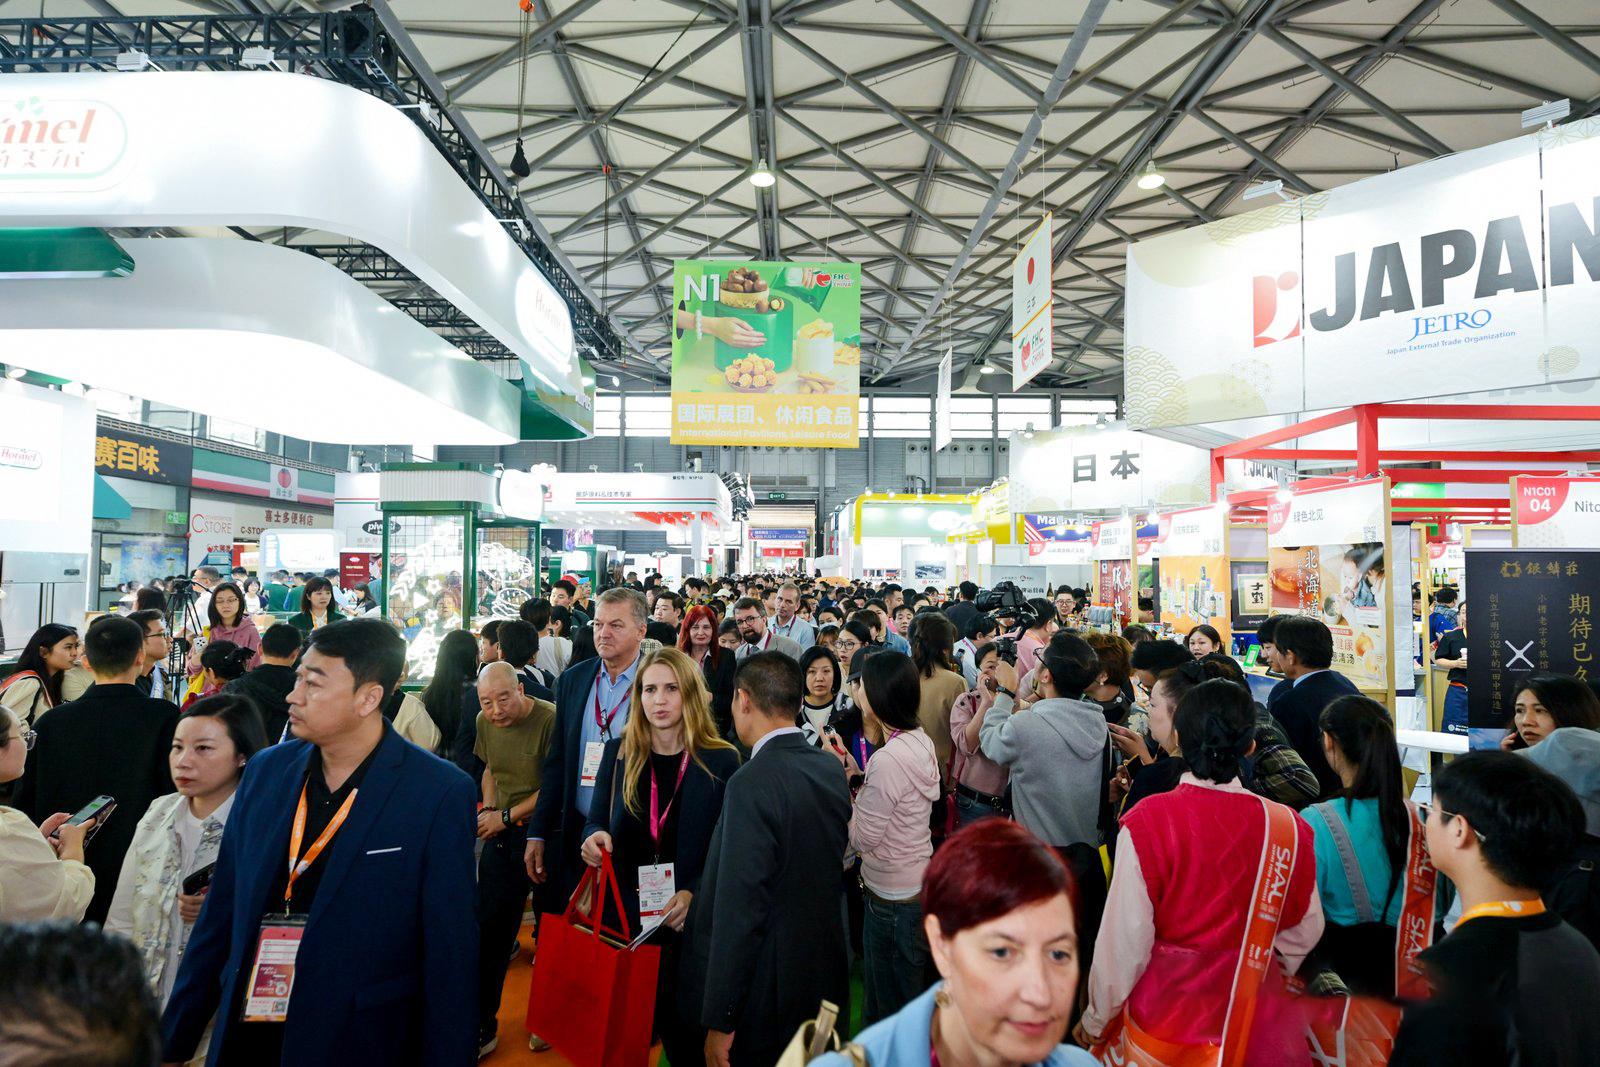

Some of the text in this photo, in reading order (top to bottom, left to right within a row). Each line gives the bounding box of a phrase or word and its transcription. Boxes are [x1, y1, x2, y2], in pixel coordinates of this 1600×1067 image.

[1310, 197, 1600, 333] JAPAN
[684, 274, 720, 302] N1
[1031, 327, 1044, 347] FHC
[1408, 308, 1492, 343] JETRO
[1387, 331, 1516, 355] Japan External Trade Organization
[678, 404, 852, 425] 国际展团、休闲食品
[680, 429, 742, 437] International
[791, 431, 824, 439] Leisure
[827, 431, 850, 439] Food
[96, 437, 160, 476] 赛百味
[1073, 450, 1140, 482] 日本
[1524, 486, 1556, 497] N1C01
[265, 509, 314, 527] 喜士多便利店
[1529, 498, 1551, 512] 04
[1304, 550, 1320, 617] 北海道
[1568, 593, 1593, 683] 期待已久
